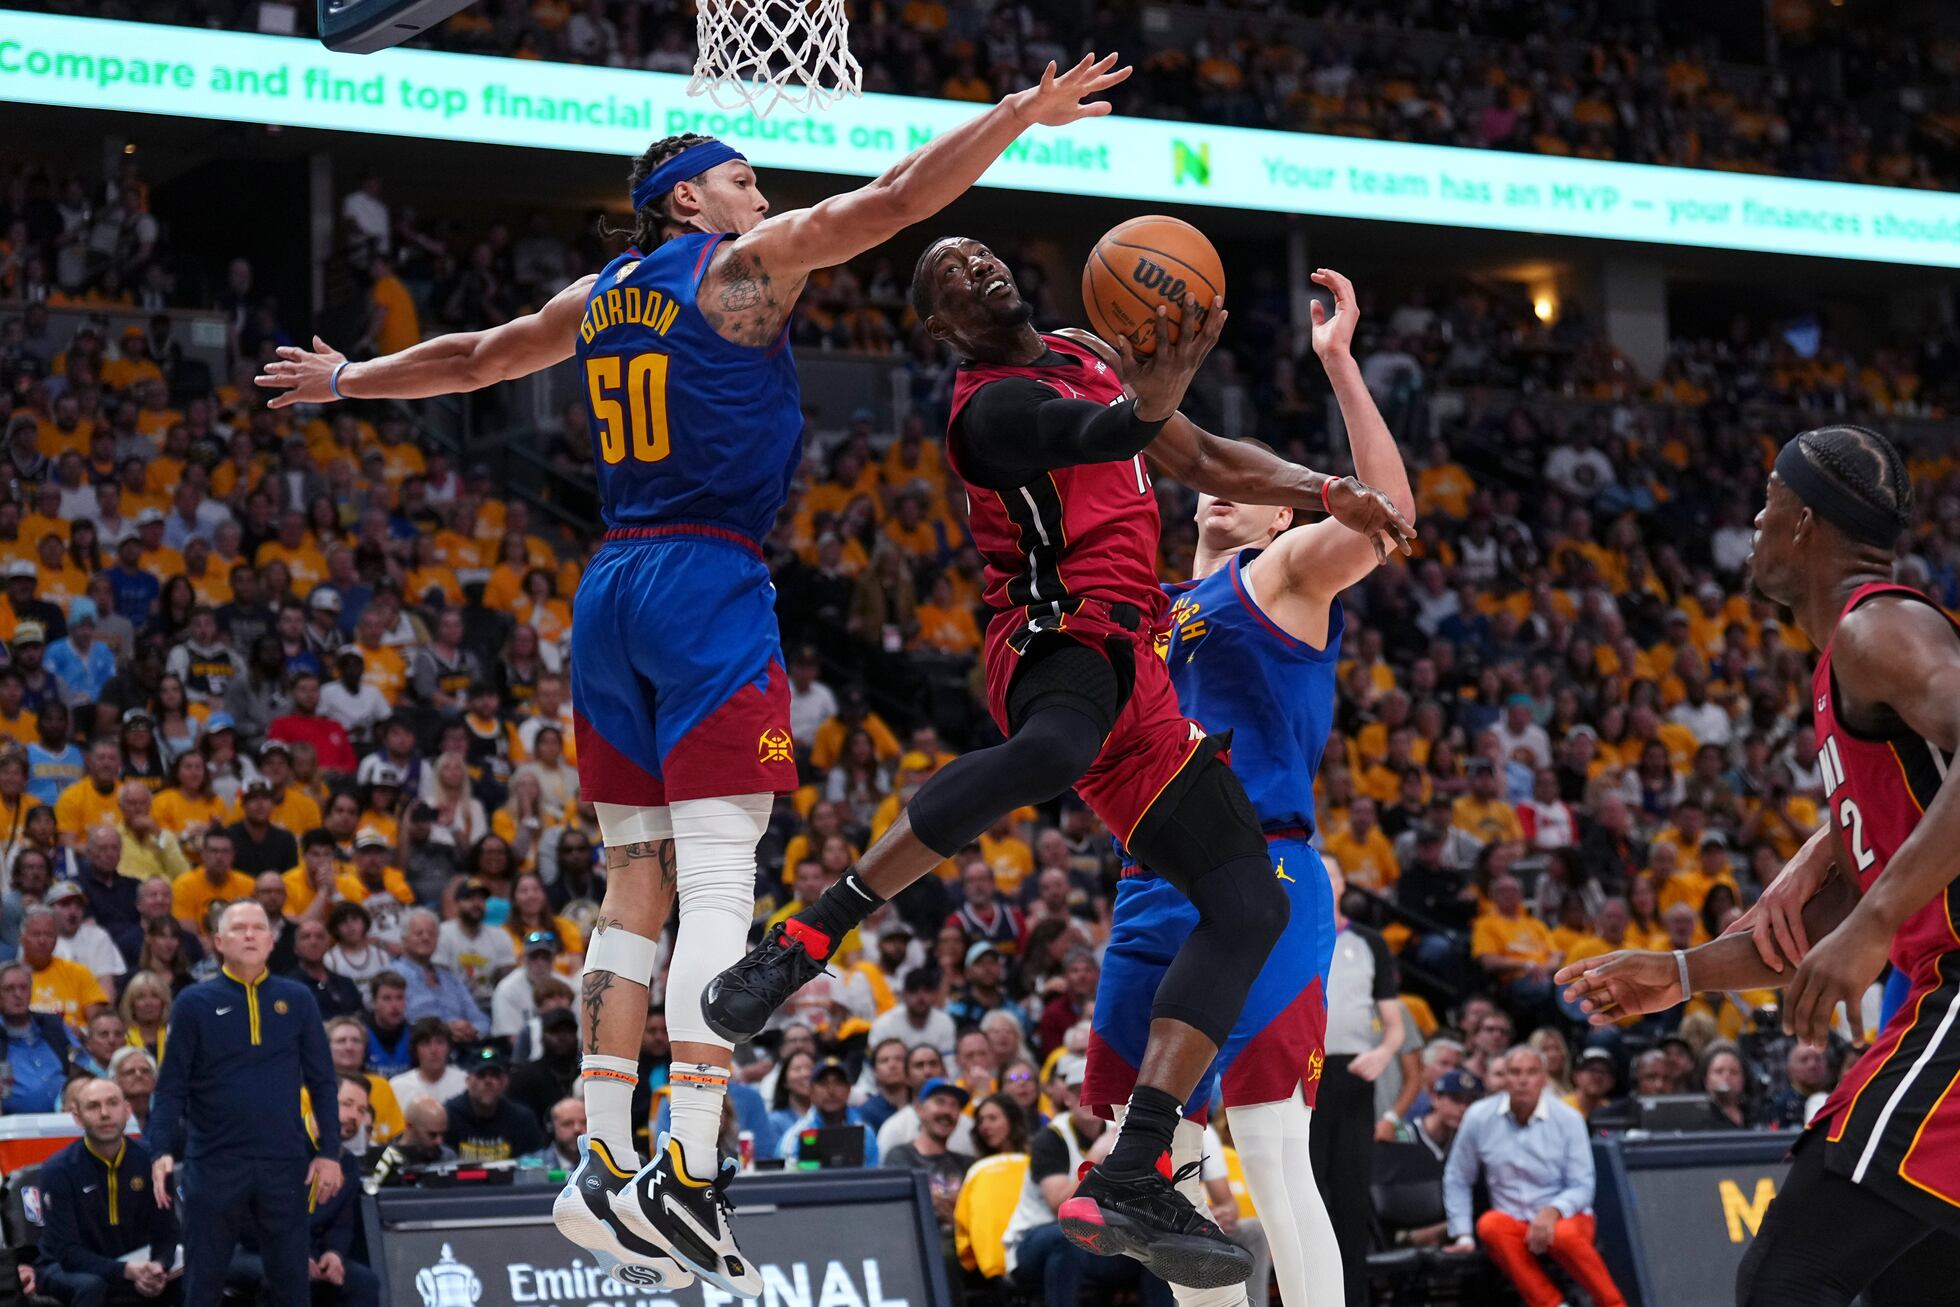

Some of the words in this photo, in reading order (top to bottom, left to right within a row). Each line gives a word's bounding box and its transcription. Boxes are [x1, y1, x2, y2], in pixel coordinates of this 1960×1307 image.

[0, 40, 195, 88] Compare
[210, 66, 288, 97] and
[303, 68, 385, 106] find
[399, 79, 468, 118] top
[482, 85, 652, 130] financial
[665, 107, 837, 148] products
[849, 126, 894, 150] on
[1263, 157, 1335, 190] Your
[1348, 166, 1430, 198] team
[1440, 171, 1492, 203] has
[1504, 183, 1540, 206] an
[1551, 184, 1620, 212] MVP
[1666, 199, 1731, 226] your
[1742, 199, 1862, 235] finances
[580, 287, 680, 345] GORDON
[585, 352, 672, 465] 50
[701, 1258, 910, 1307] FNAL
